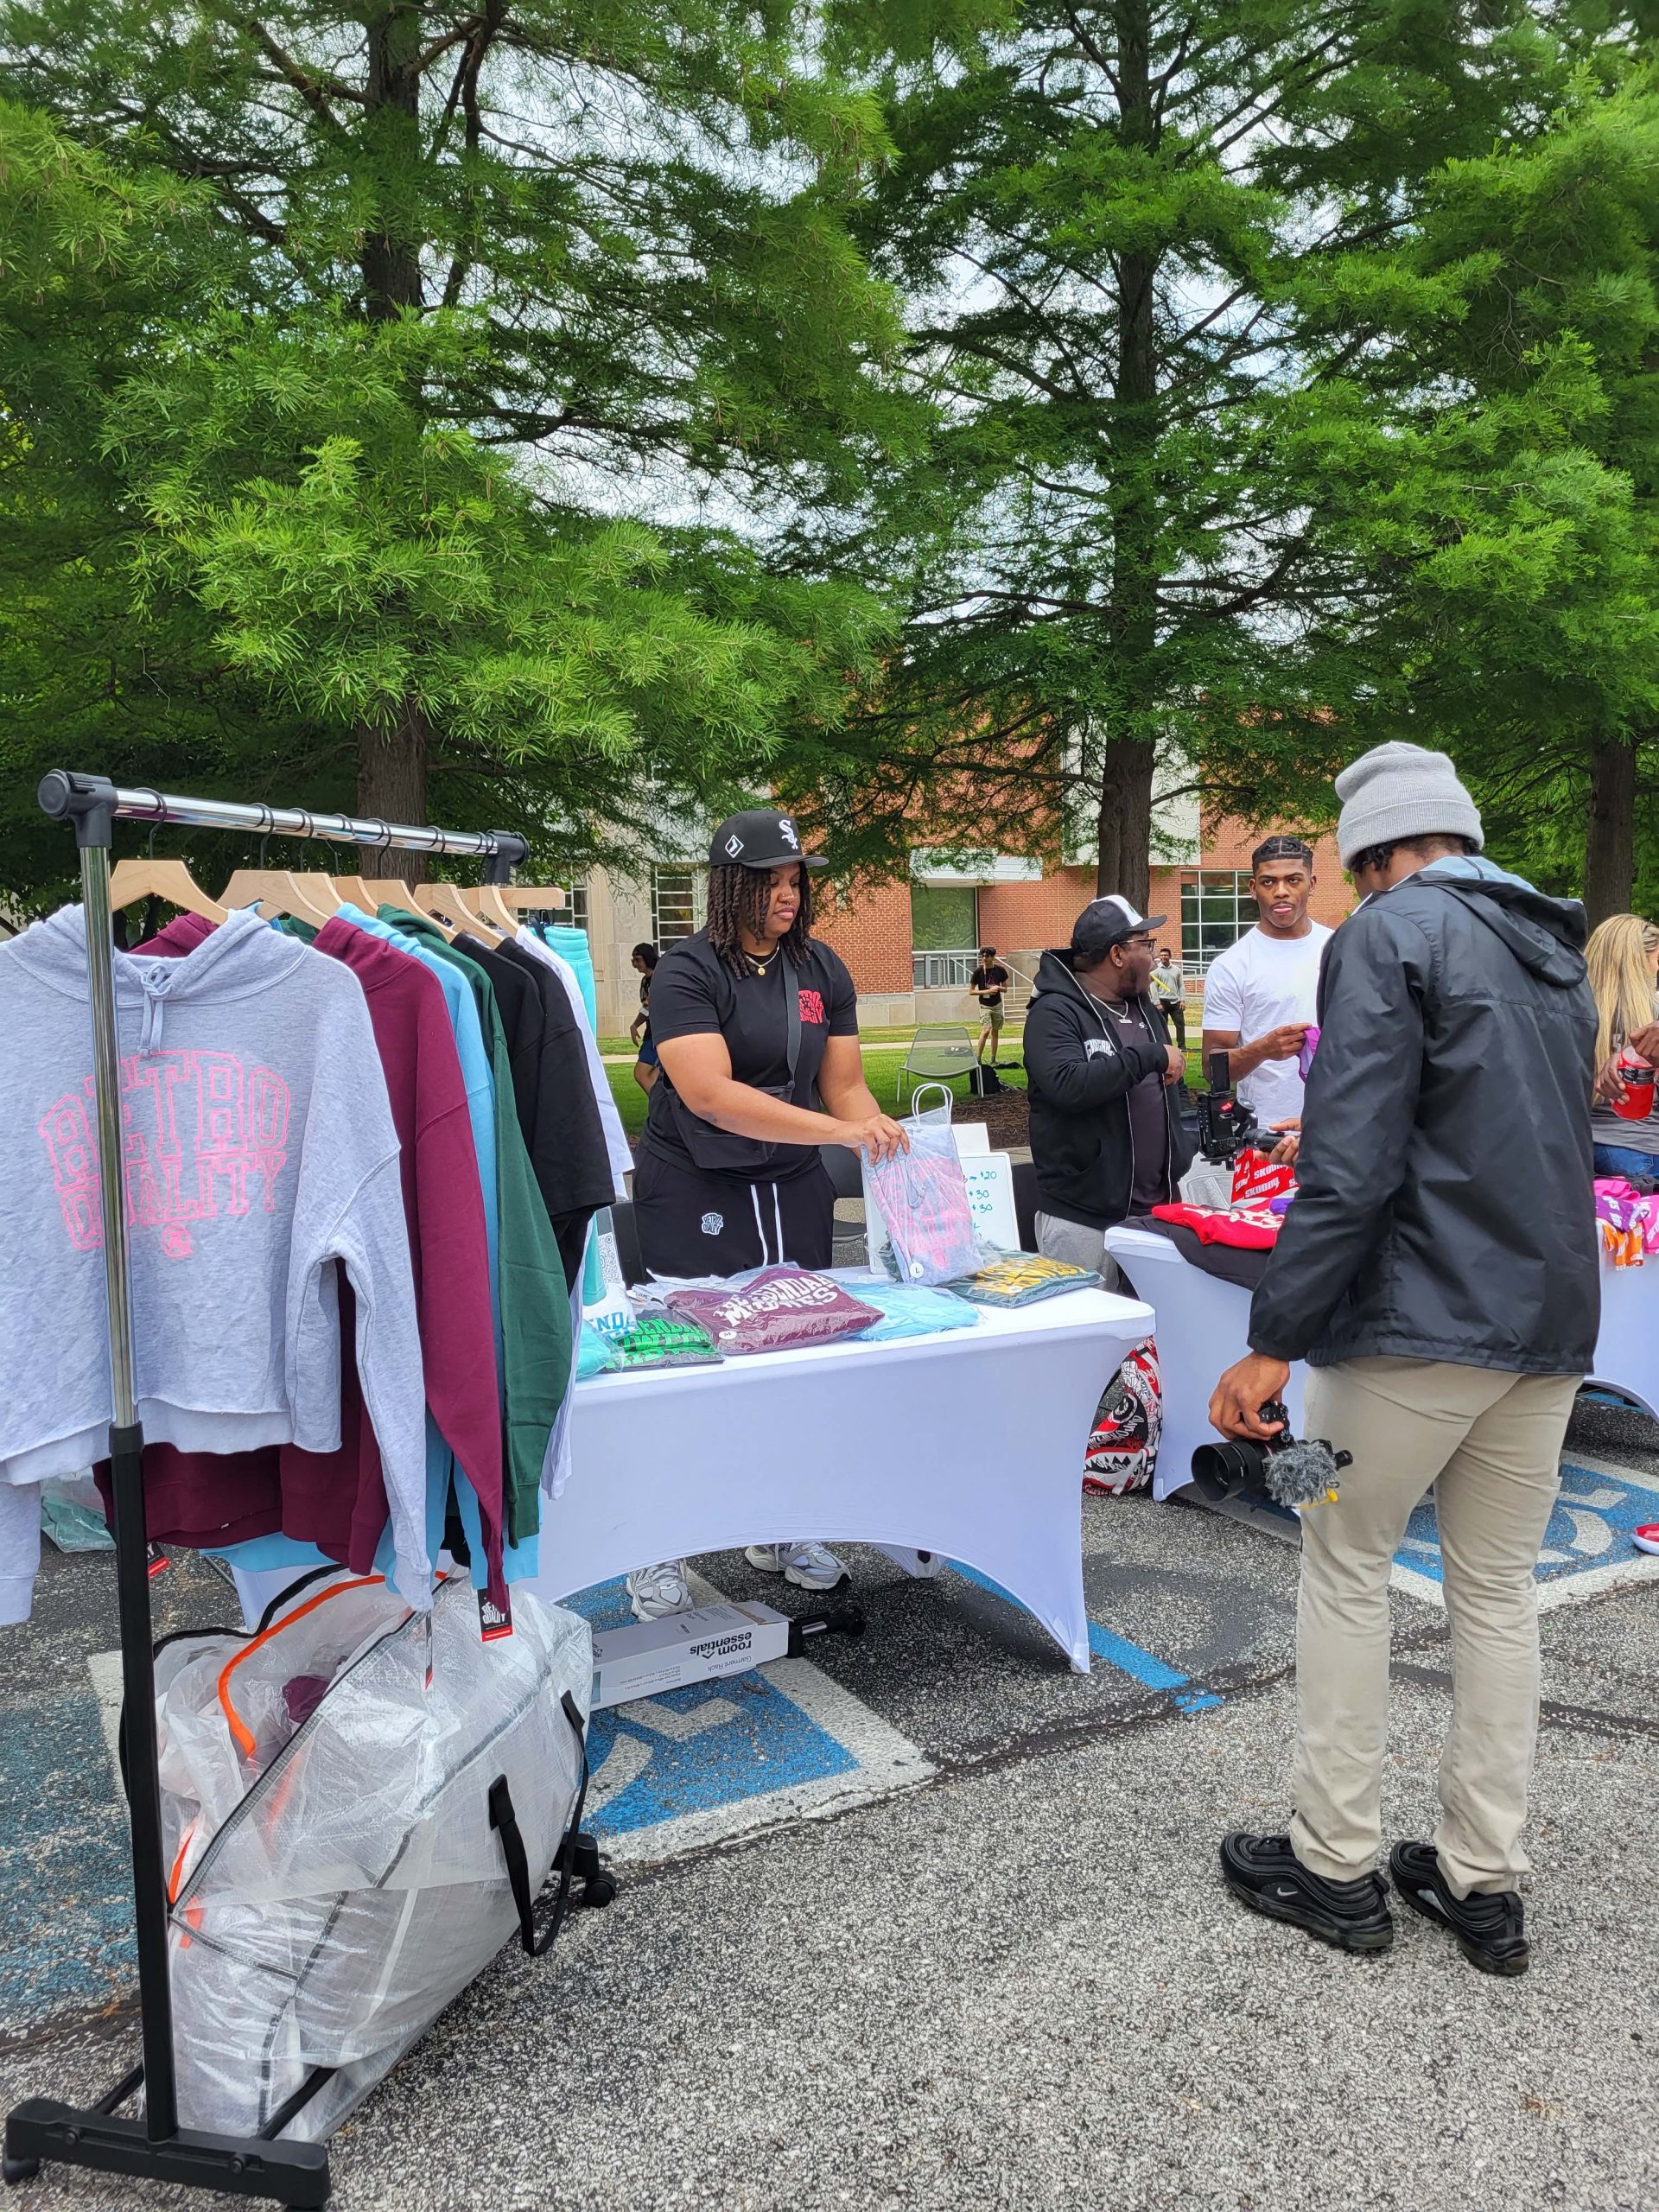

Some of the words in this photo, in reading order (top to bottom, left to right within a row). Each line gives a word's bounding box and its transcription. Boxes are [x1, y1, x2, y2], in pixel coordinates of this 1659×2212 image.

[60, 1151, 287, 1252] QALITY
[690, 1631, 753, 1656] essentials
[718, 1640, 752, 1656] room
[707, 1663, 723, 1673] Rack
[724, 1656, 752, 1667] Garment
